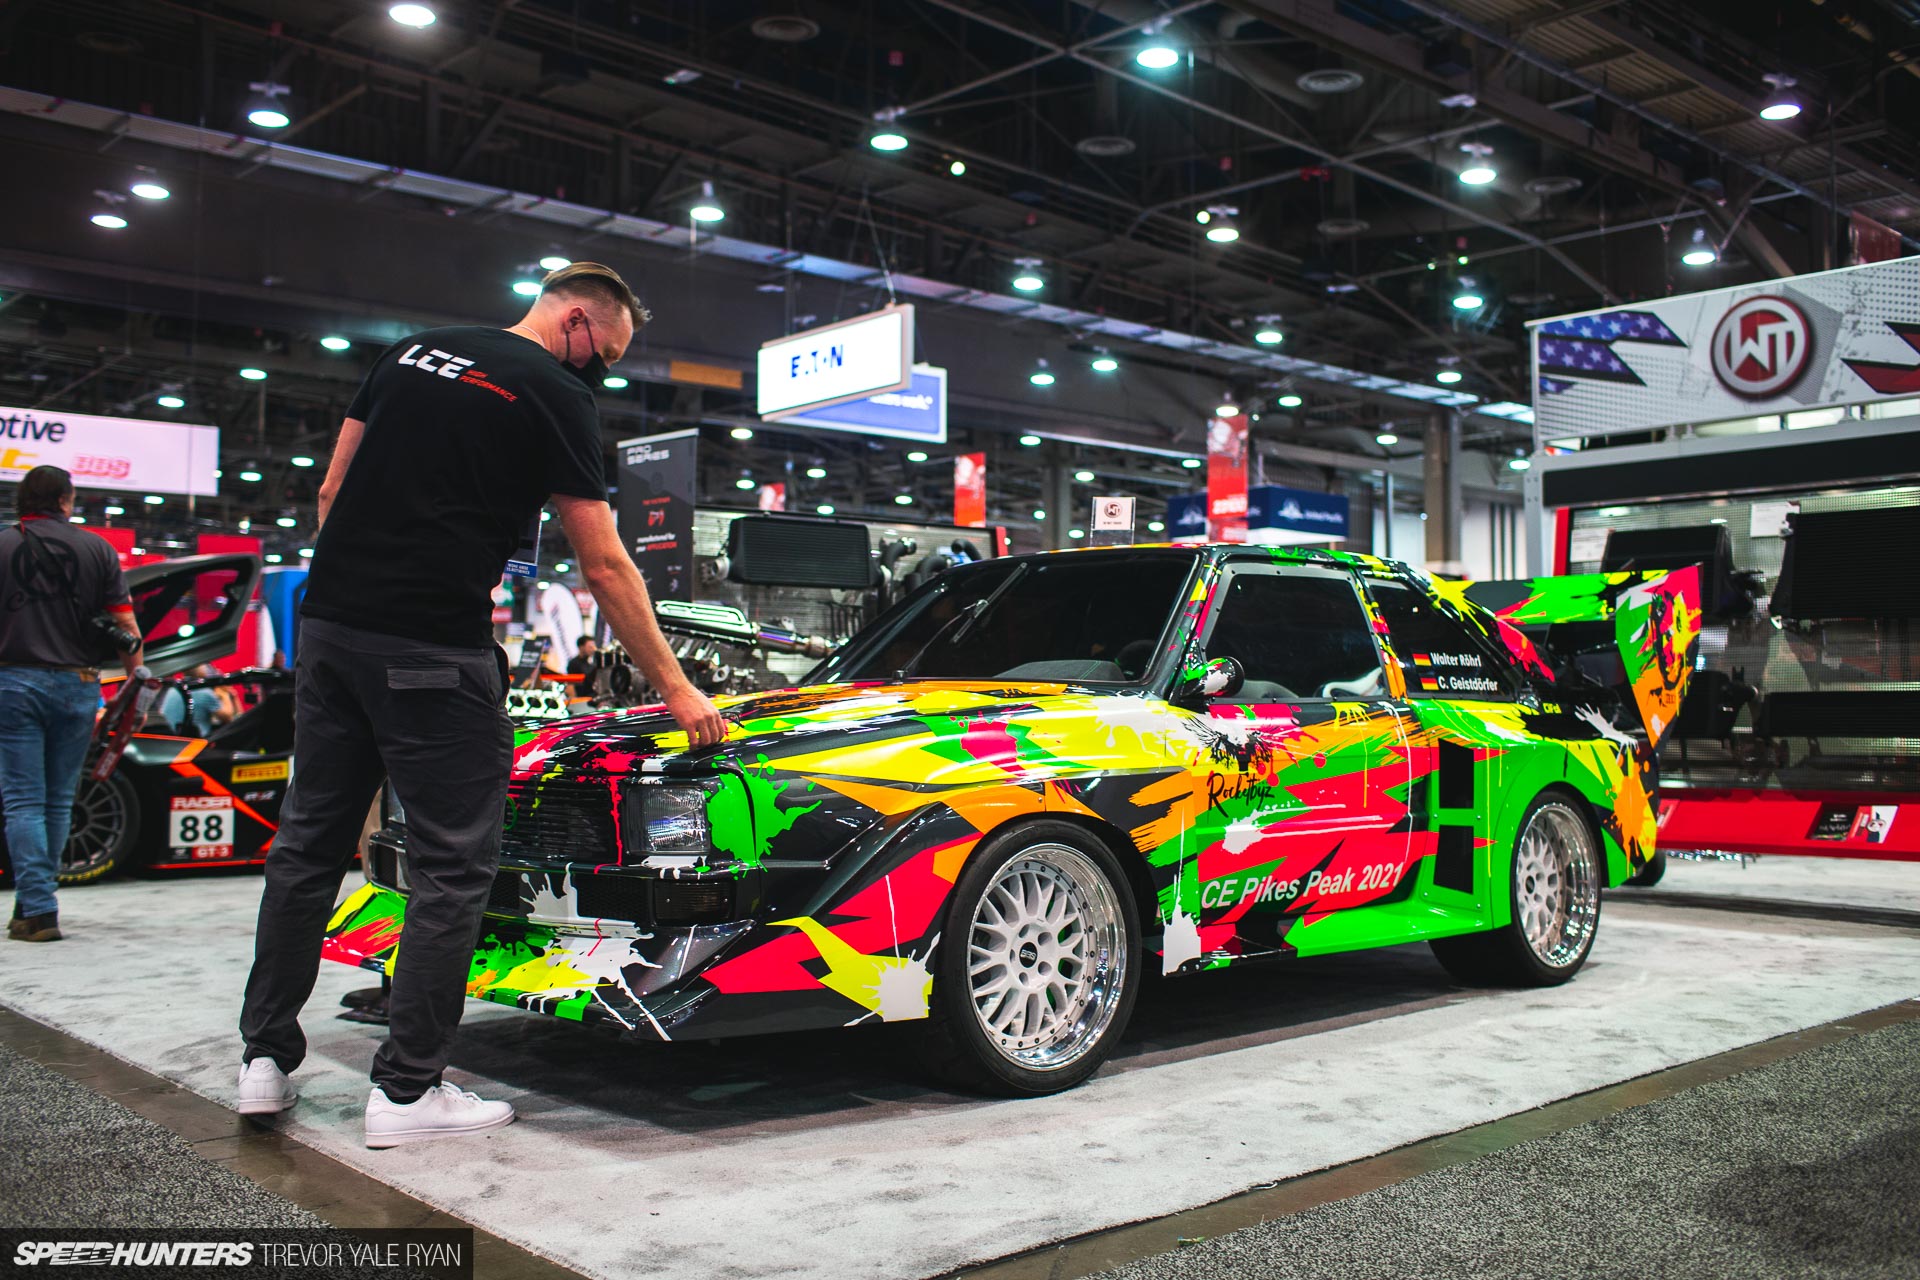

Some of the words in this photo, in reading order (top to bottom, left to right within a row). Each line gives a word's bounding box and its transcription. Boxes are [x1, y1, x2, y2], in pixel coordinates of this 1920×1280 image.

[398, 344, 476, 379] LCE
[791, 344, 843, 378] ETN
[459, 375, 518, 402] PERFORMANCE
[1430, 652, 1458, 666] Walter
[1459, 654, 1482, 667] Röhrl
[1438, 676, 1450, 689] C.
[1450, 677, 1498, 691] Geistdörfer
[174, 797, 233, 809] RACER
[180, 815, 223, 842] 88
[1202, 879, 1238, 909] CE
[1239, 874, 1300, 905] Pikes
[1303, 866, 1356, 896] Peak
[1357, 862, 1404, 891] 2021
